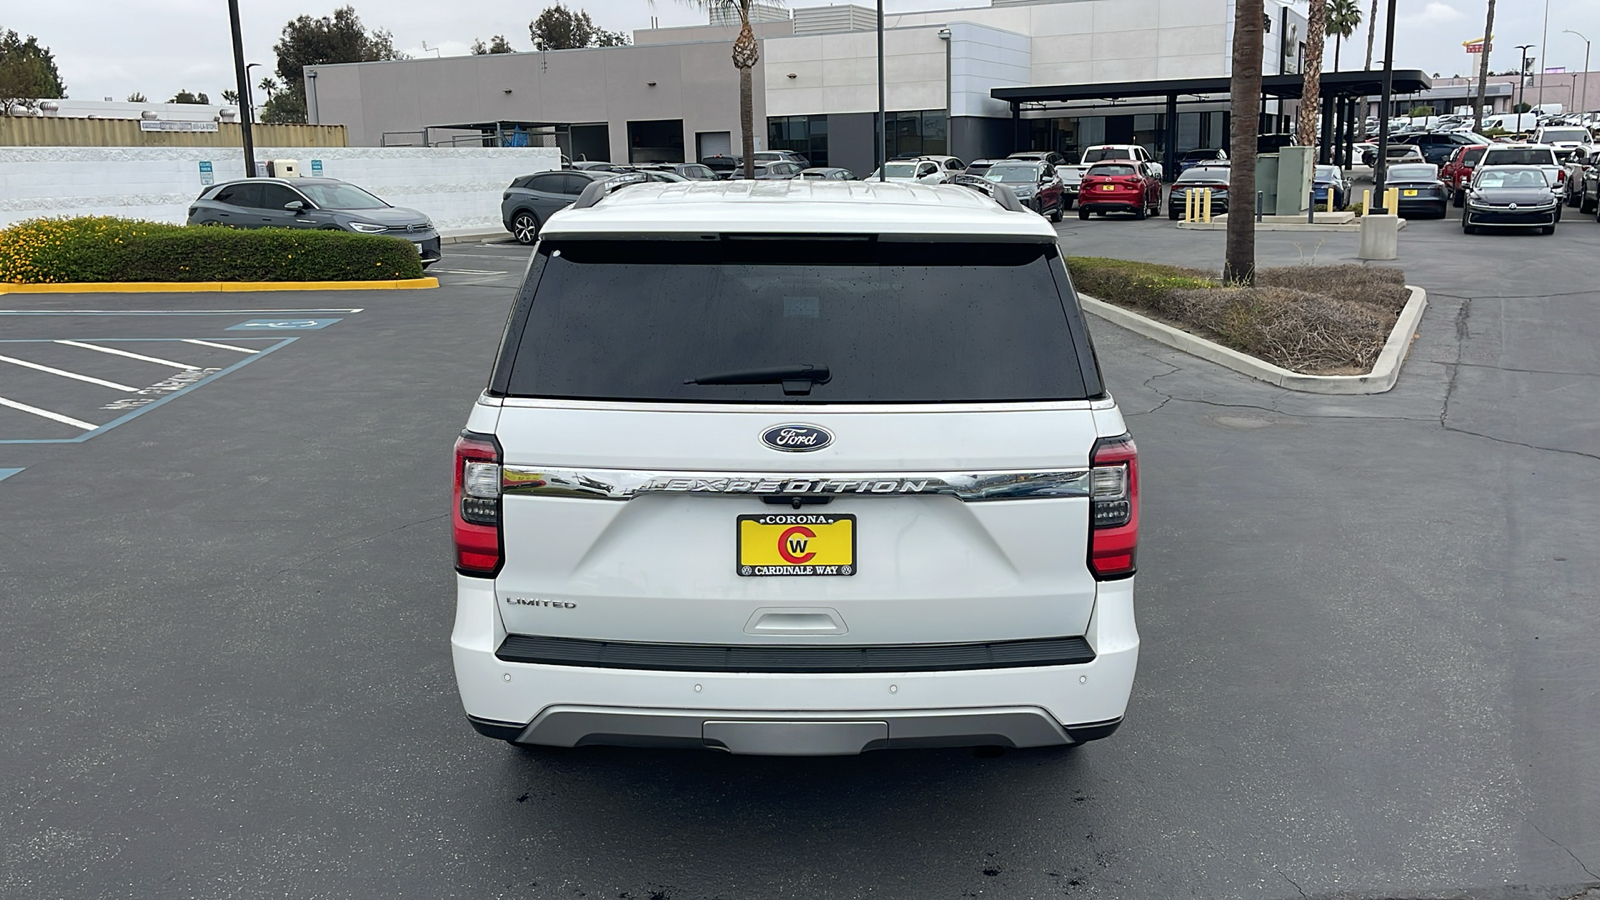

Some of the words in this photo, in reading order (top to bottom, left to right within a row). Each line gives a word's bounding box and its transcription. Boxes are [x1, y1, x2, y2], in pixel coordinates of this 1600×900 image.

[776, 428, 818, 445] Ford
[664, 479, 928, 493] EXPEDITION
[766, 515, 827, 524] CORONA
[755, 566, 813, 575] CARDINALE
[816, 566, 838, 575] WAY
[506, 596, 577, 609] LIMITED
